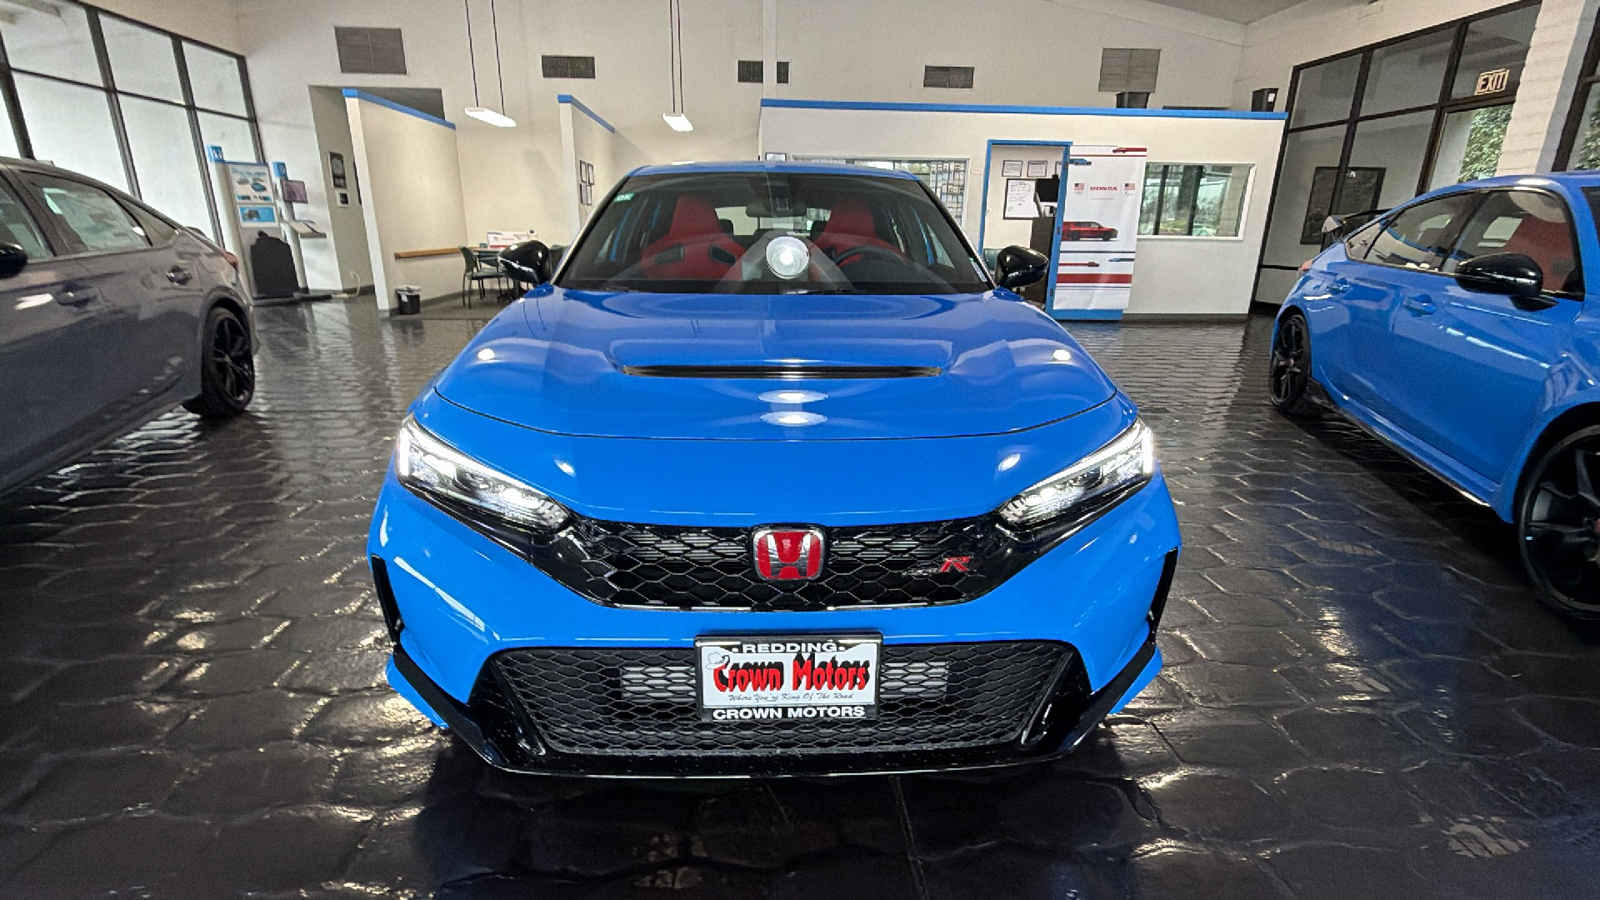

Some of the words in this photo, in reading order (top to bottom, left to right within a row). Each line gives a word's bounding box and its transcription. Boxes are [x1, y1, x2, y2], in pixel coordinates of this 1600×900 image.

[1480, 72, 1506, 92] EXIT
[940, 556, 971, 572] R
[742, 642, 838, 653] REDDING
[713, 654, 784, 692] Crown
[792, 652, 870, 691] Motors
[781, 693, 800, 701] King
[803, 692, 814, 701] Of
[816, 692, 831, 700] The
[713, 707, 783, 719] CROWN
[787, 706, 865, 718] MOTORS
